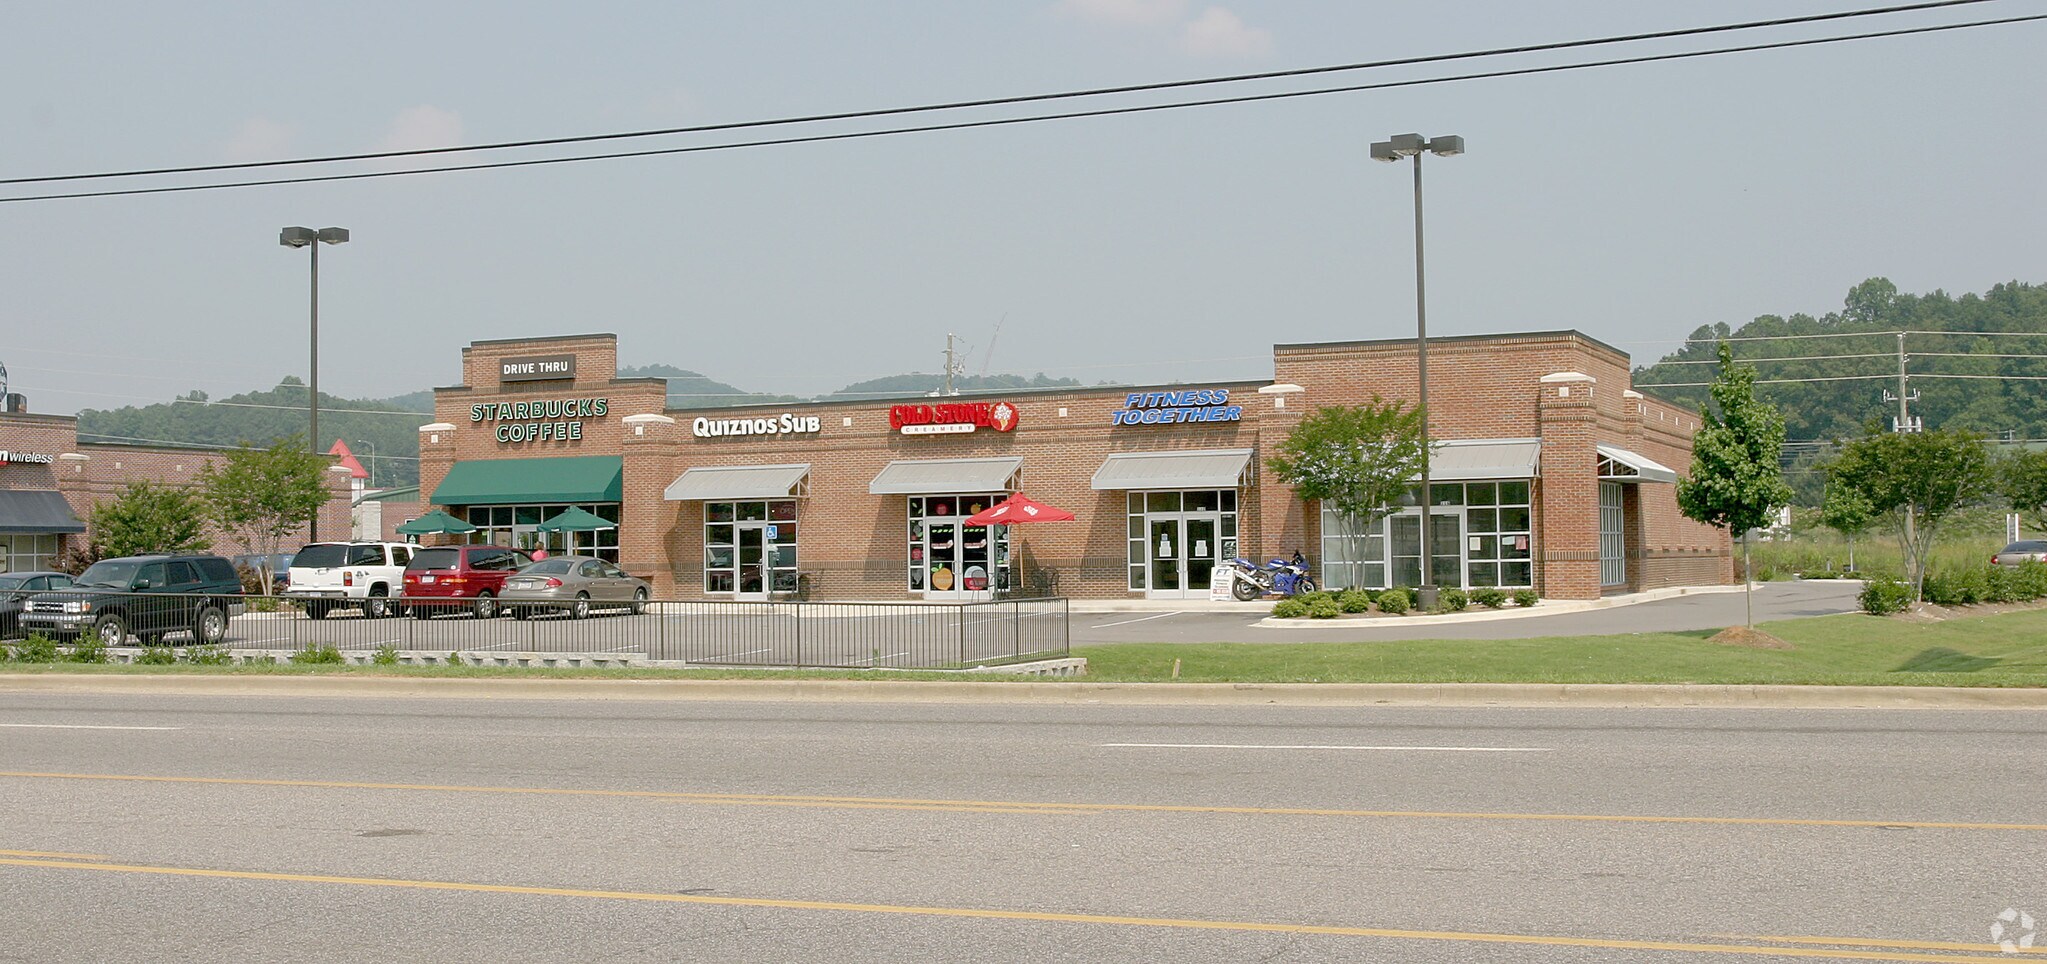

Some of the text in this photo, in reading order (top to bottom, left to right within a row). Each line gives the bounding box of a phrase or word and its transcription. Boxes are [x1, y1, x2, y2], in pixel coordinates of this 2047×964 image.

[503, 361, 568, 374] DRIVE THRU
[1124, 389, 1229, 408] FITNESS
[470, 398, 608, 421] STARBUCKS
[889, 402, 991, 430] COLD STONE
[1111, 406, 1242, 425] TOGETHER
[495, 422, 582, 442] COFFEE
[905, 425, 972, 433] CREAMERY
[9, 452, 53, 463] wireless
